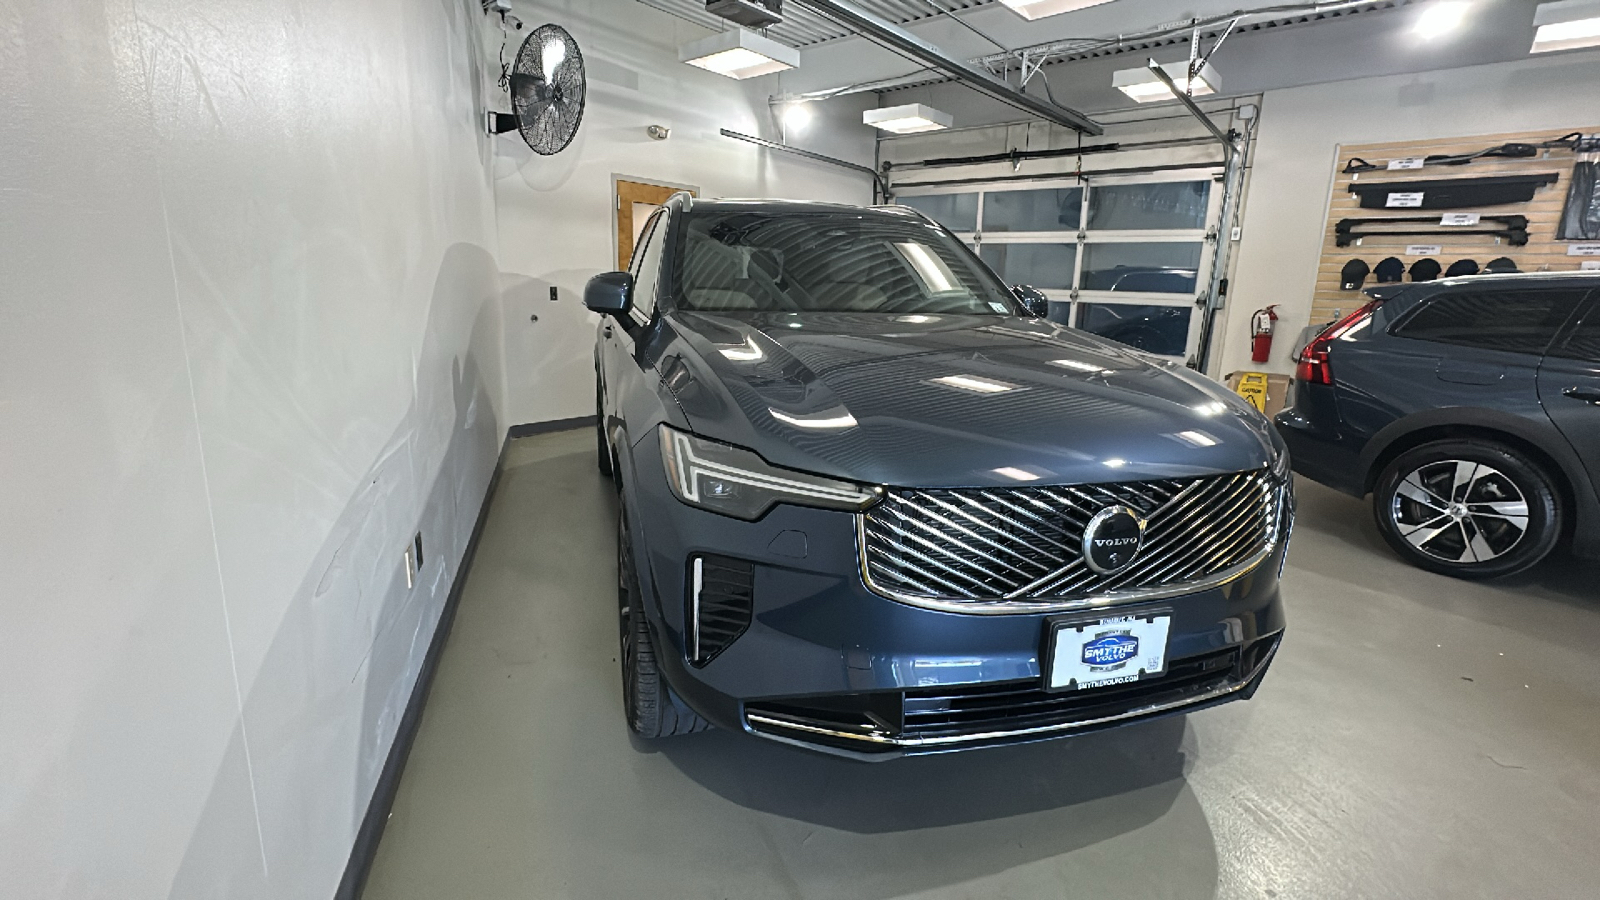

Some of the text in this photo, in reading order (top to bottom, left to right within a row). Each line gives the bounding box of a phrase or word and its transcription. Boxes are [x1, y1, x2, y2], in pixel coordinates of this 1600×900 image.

[1094, 537, 1137, 547] VOLVO
[1084, 645, 1135, 658] SMYTHE
[1096, 652, 1126, 662] VOLVO
